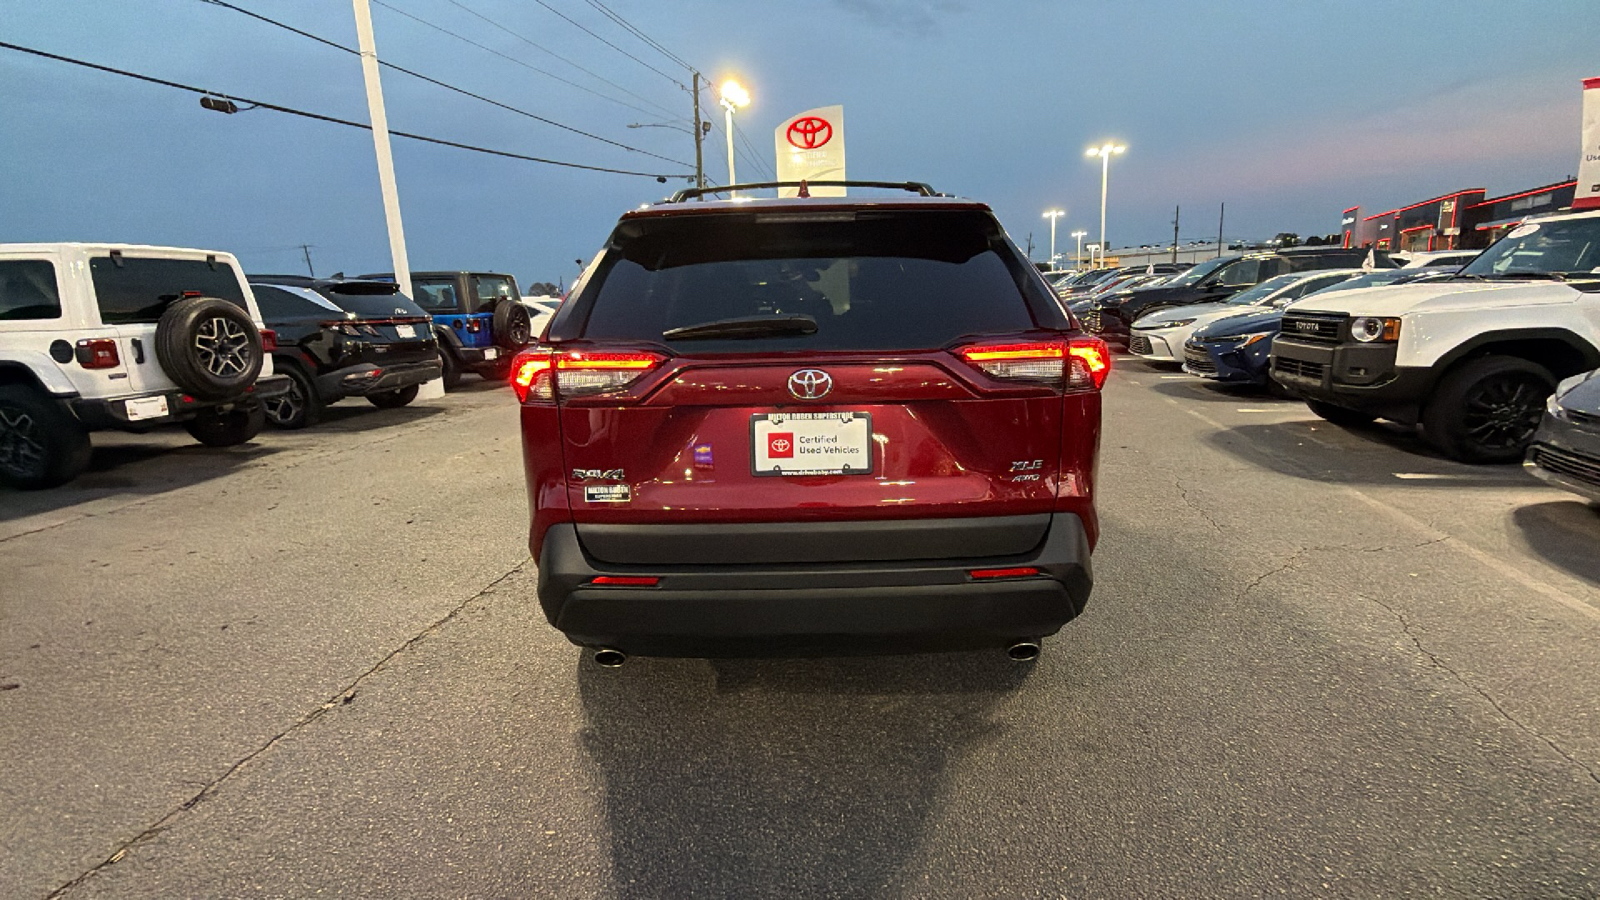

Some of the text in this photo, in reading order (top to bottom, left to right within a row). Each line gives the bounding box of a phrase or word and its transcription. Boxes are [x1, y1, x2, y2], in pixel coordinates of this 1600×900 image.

[1295, 321, 1319, 331] TOYOTA
[799, 435, 838, 444] Certified
[799, 446, 860, 454] Used Vehicles
[1012, 459, 1044, 470] XLE
[572, 468, 625, 480] RAV4
